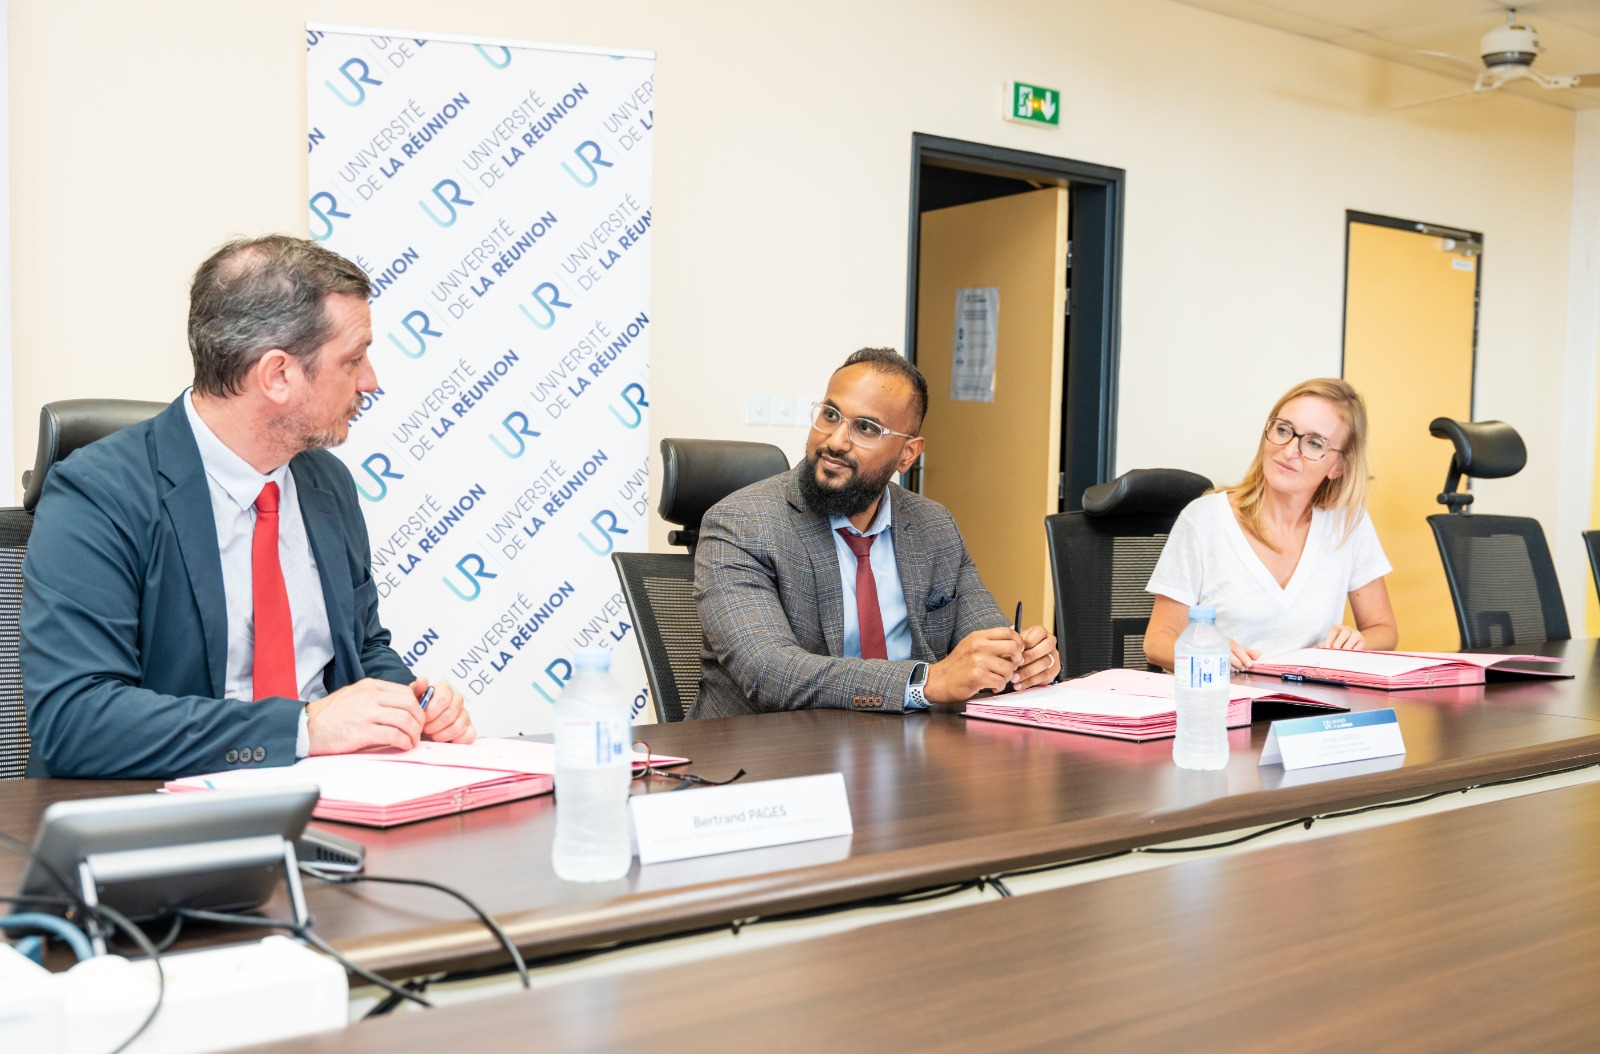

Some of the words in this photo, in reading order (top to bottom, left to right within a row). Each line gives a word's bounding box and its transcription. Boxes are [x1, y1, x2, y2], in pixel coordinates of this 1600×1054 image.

[324, 57, 383, 107] UR
[388, 43, 414, 69] DE
[338, 98, 426, 183] UNIVERSITÉ
[461, 88, 546, 172] UNIVERSITÉ
[479, 163, 505, 189] DE
[501, 145, 526, 168] LA
[521, 82, 590, 149] RÉUNION
[603, 74, 654, 133] UNIVER
[618, 126, 643, 151] DE
[640, 110, 653, 131] L
[356, 174, 384, 201] DE
[379, 157, 405, 179] LA
[400, 92, 471, 159] RÉUNION
[560, 139, 614, 188] UR
[417, 178, 475, 228] UR
[560, 192, 641, 274] UNIVERSITÉ
[368, 246, 420, 305] UNION
[430, 218, 515, 303] UNIVERSITÉ
[447, 294, 474, 320] DE
[470, 276, 495, 298] LA
[491, 210, 559, 277] RÉUNION
[577, 266, 602, 291] DE
[598, 249, 621, 270] LA
[618, 206, 652, 251] RÉUN
[386, 309, 444, 360] UR
[518, 281, 573, 330] UR
[392, 358, 477, 444] UNIVERSITÉ
[529, 319, 612, 404] UNIVERSITÉ
[545, 393, 571, 420] DE
[567, 375, 592, 398] LA
[587, 311, 650, 377] RÉUNION
[409, 436, 435, 462] DE
[430, 417, 456, 439] LA
[451, 348, 520, 418] RÉUNION
[488, 410, 542, 460] UR
[608, 382, 649, 429] UR
[355, 452, 405, 503] UR
[486, 459, 567, 545] UNIVERSITÉ
[502, 535, 527, 561] DE
[522, 516, 546, 538] LA
[542, 449, 609, 517] RÉUNION
[370, 493, 442, 576] NIVERSITÉ
[376, 571, 402, 599] DE
[397, 553, 422, 575] LA
[417, 483, 487, 554] RÉUNION
[576, 509, 629, 557] UR
[441, 553, 498, 602] UR
[451, 591, 533, 680] UNIVERSITÉ
[468, 669, 494, 696] DE
[490, 651, 514, 673] LA
[510, 580, 575, 650] RÉUNION
[573, 592, 626, 648] UNIVER
[610, 620, 632, 642] LA
[692, 811, 746, 829] Bertrand
[748, 804, 787, 821] PAGES
